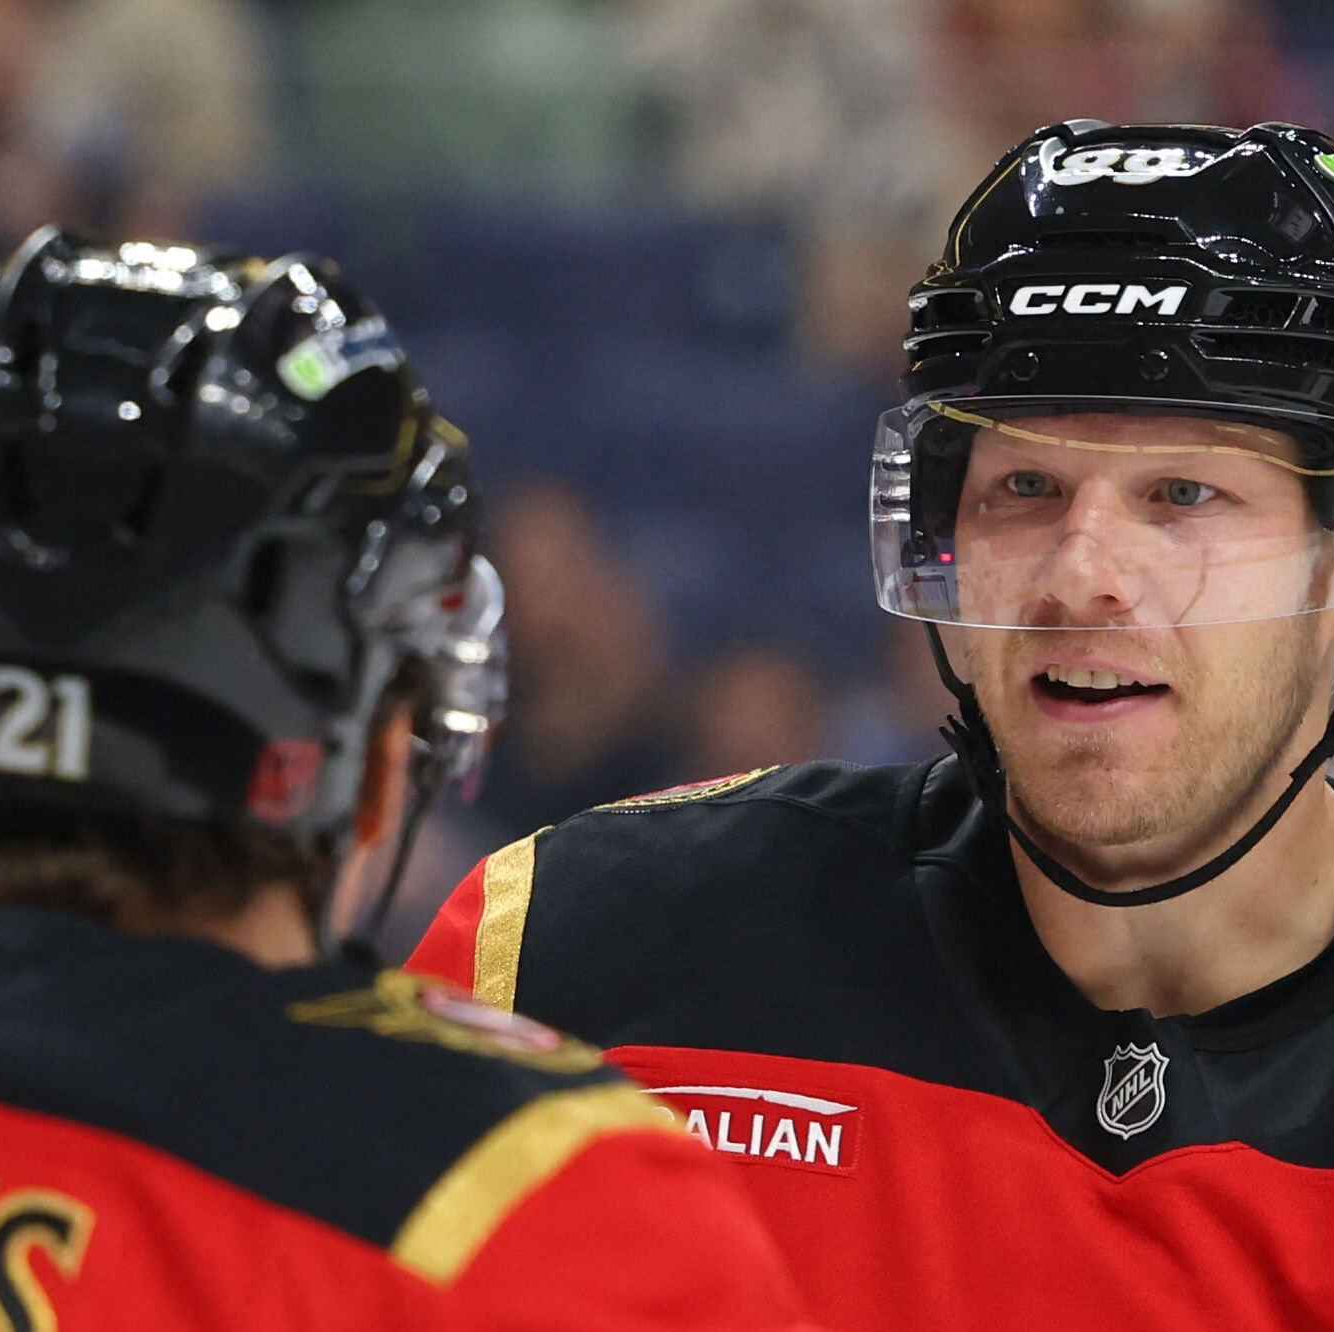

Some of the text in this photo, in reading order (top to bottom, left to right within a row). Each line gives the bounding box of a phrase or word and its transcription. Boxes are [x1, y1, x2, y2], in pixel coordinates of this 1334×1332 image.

[1008, 283, 1188, 316] CCM
[1111, 1067, 1152, 1118] NHL
[653, 1106, 843, 1167] ALIAN
